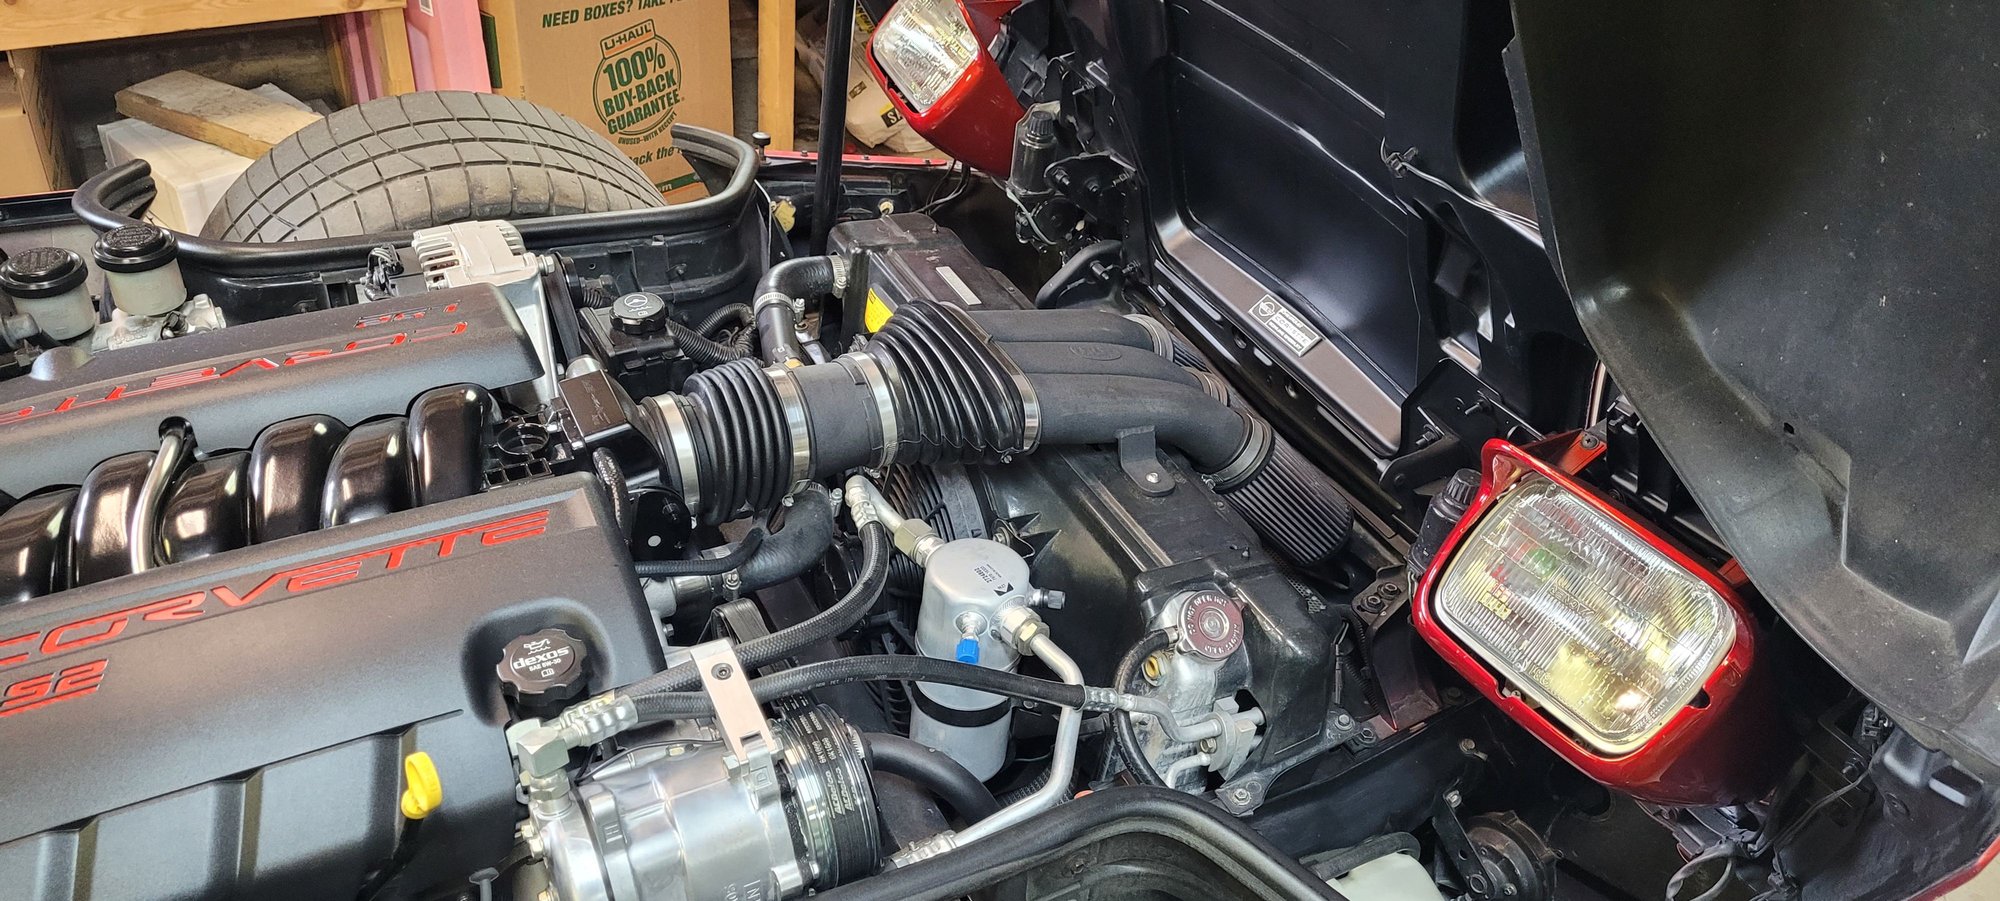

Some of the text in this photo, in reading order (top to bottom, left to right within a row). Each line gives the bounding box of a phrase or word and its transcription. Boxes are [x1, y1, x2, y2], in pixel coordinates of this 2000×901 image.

[542, 9, 579, 29] NEED
[583, 0, 634, 22] BOXES?
[604, 23, 652, 50] U-HAUL
[602, 42, 666, 92] 100%
[602, 69, 677, 117] BUY-BACK
[607, 88, 680, 135] GUARANTEE
[629, 151, 653, 165] ack
[656, 146, 674, 160] the
[513, 646, 570, 670] dexos
[825, 770, 842, 814] ACDelco
